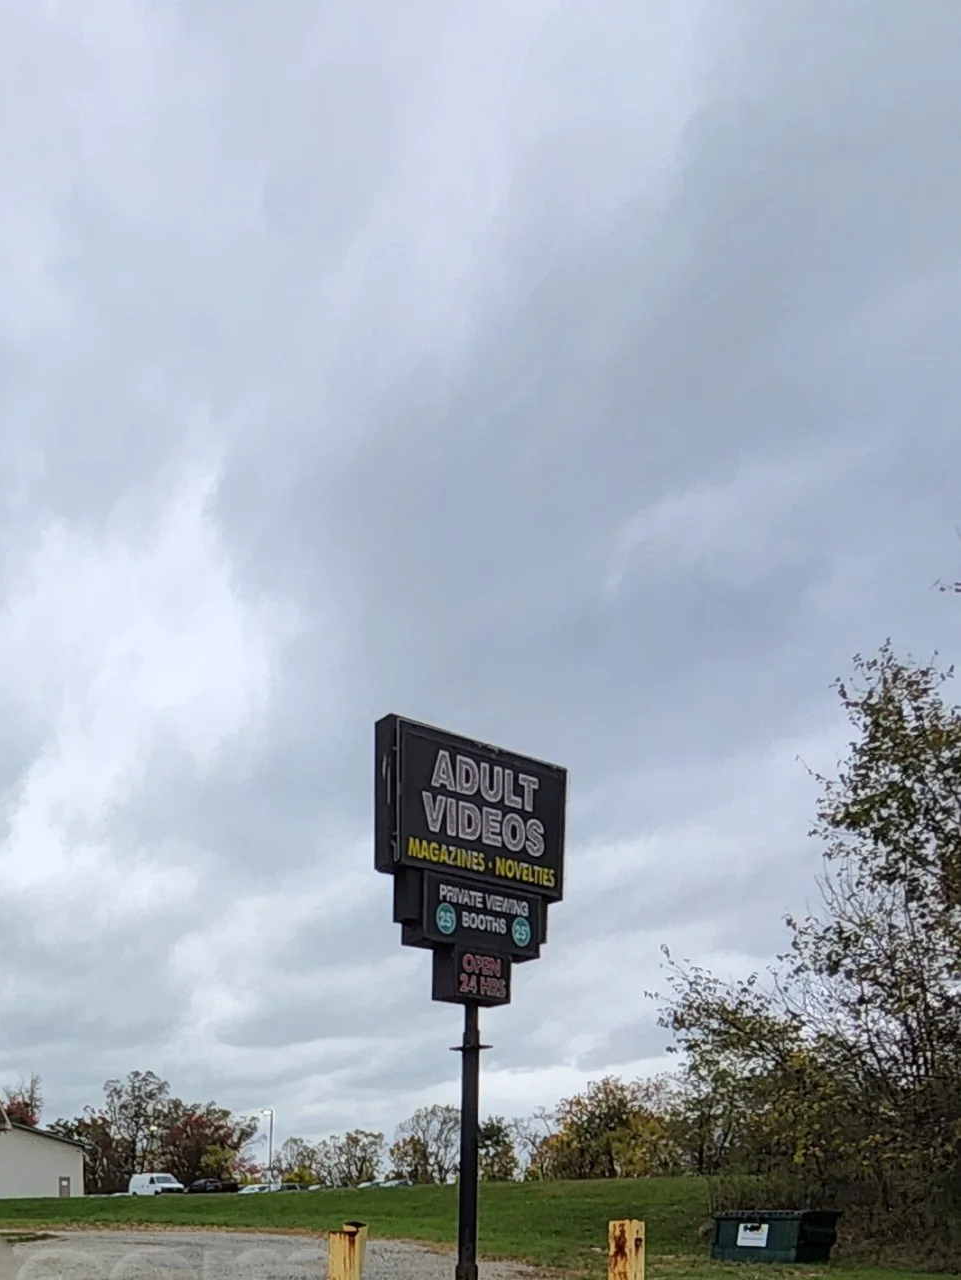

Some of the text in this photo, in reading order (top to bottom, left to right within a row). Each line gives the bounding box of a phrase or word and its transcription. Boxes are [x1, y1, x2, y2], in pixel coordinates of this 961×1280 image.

[431, 749, 539, 812] ADULT
[422, 790, 545, 858] VIDEOS
[408, 837, 555, 888] MAGAZINES NOVELTIES
[439, 884, 529, 917] PRIVATE VIEWING
[461, 911, 507, 935] BOOTHS
[462, 953, 502, 978] OPEN
[459, 973, 507, 998] 24 HRS
